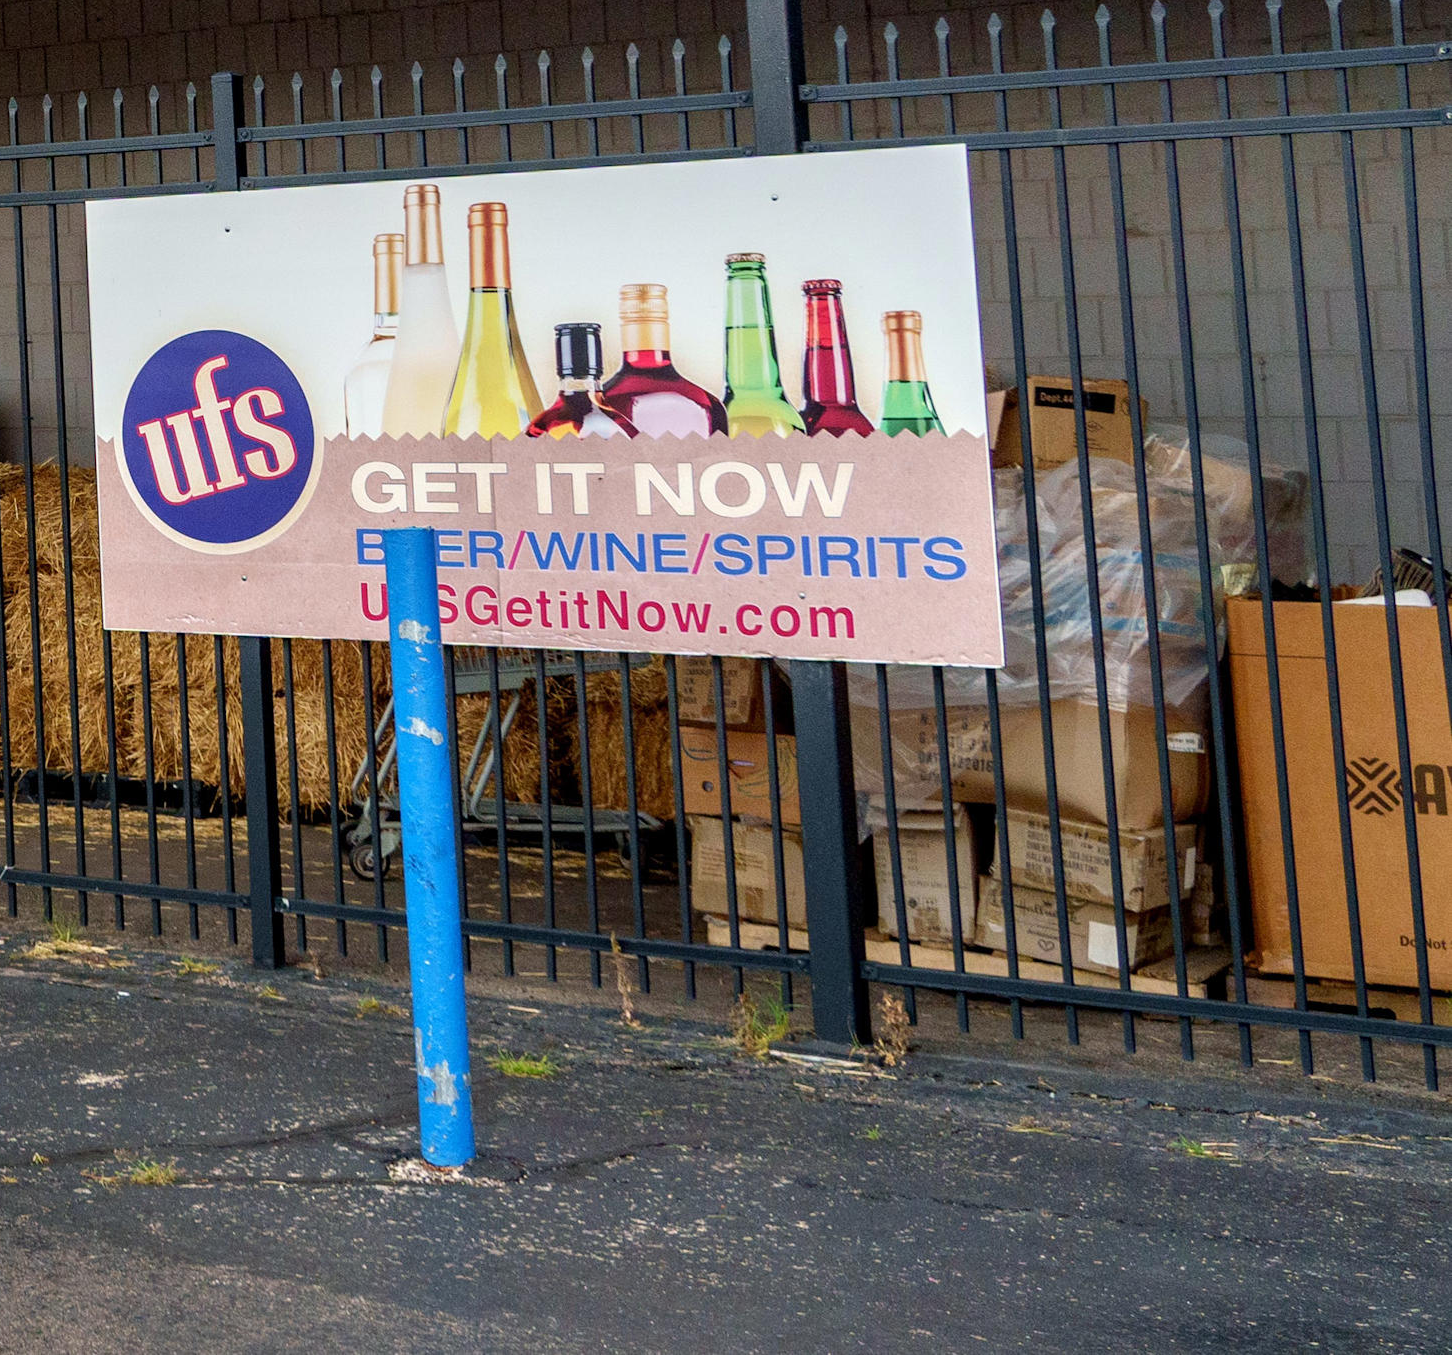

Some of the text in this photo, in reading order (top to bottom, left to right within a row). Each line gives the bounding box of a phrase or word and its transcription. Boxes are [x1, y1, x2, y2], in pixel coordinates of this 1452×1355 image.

[136, 354, 298, 506] ufs
[351, 461, 855, 518] GET IT NOW
[356, 528, 967, 580] BER/WINE/SPIRITS
[361, 582, 855, 639] USGetitNow.com
